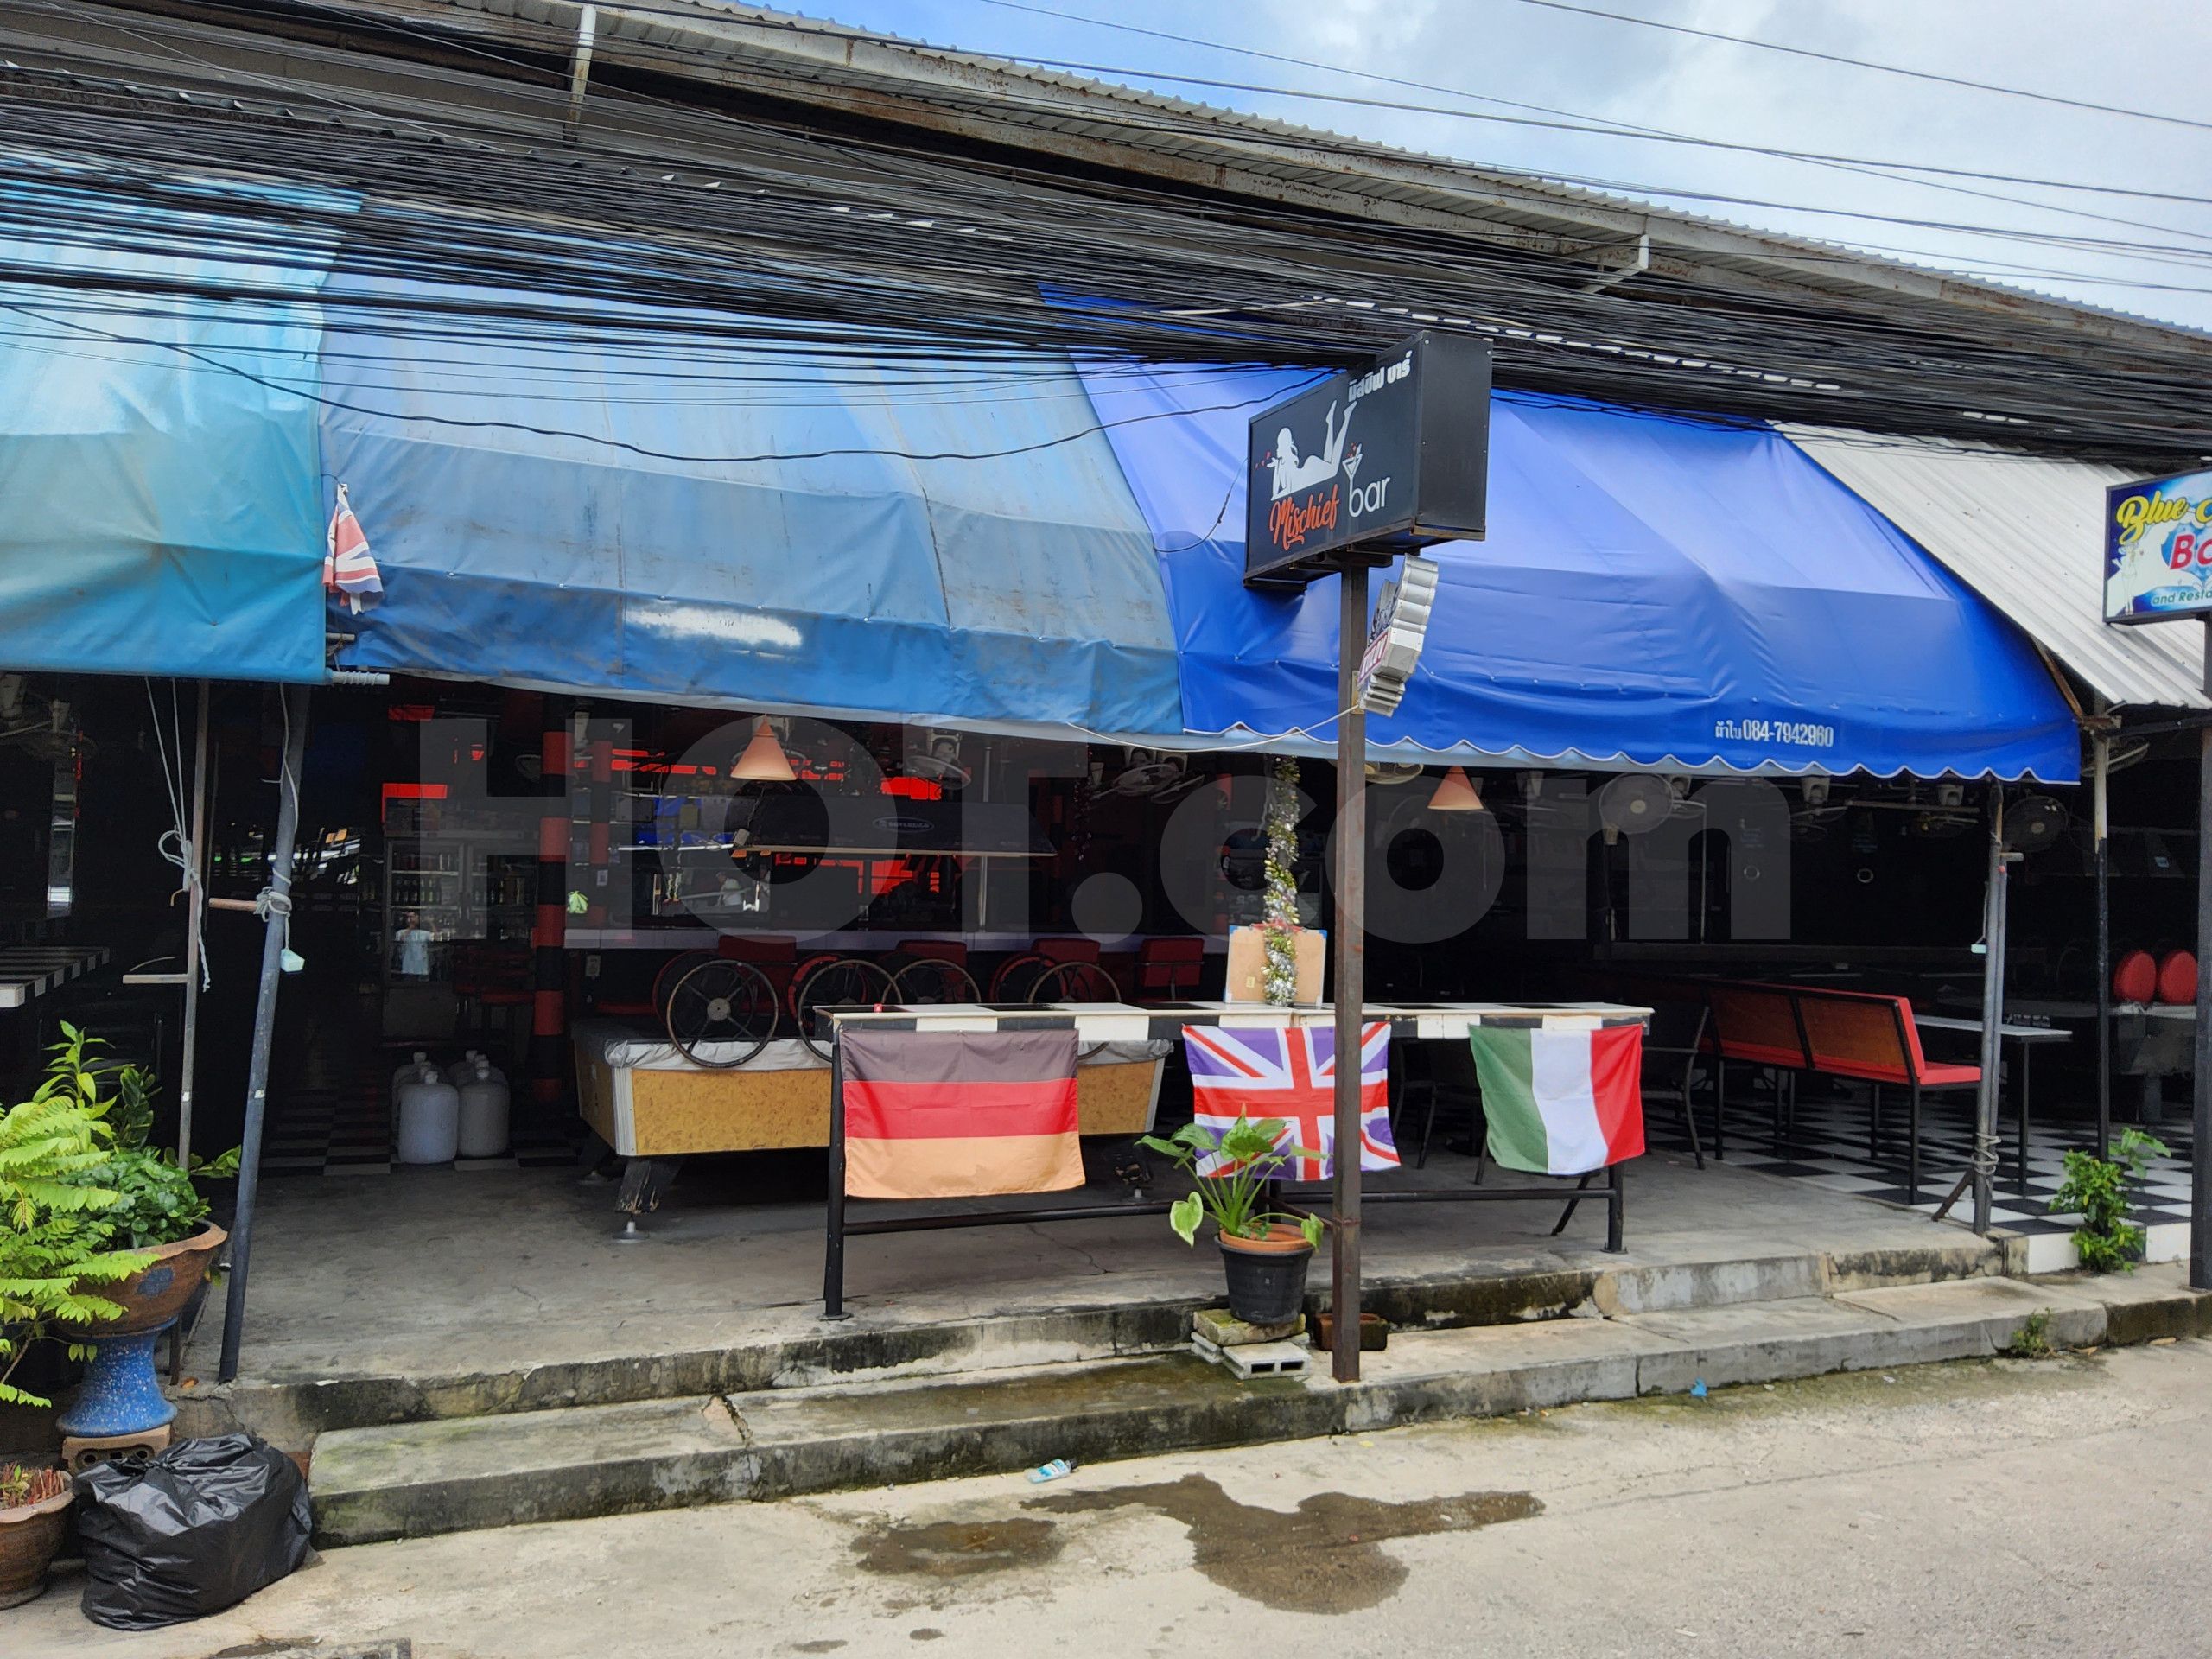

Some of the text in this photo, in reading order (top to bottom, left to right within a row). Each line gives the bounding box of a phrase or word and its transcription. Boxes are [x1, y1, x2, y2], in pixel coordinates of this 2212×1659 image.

[1269, 484, 1340, 550] Mischief
[1348, 474, 1391, 518] bar
[2116, 490, 2190, 545] Blue
[2152, 593, 2177, 605] and
